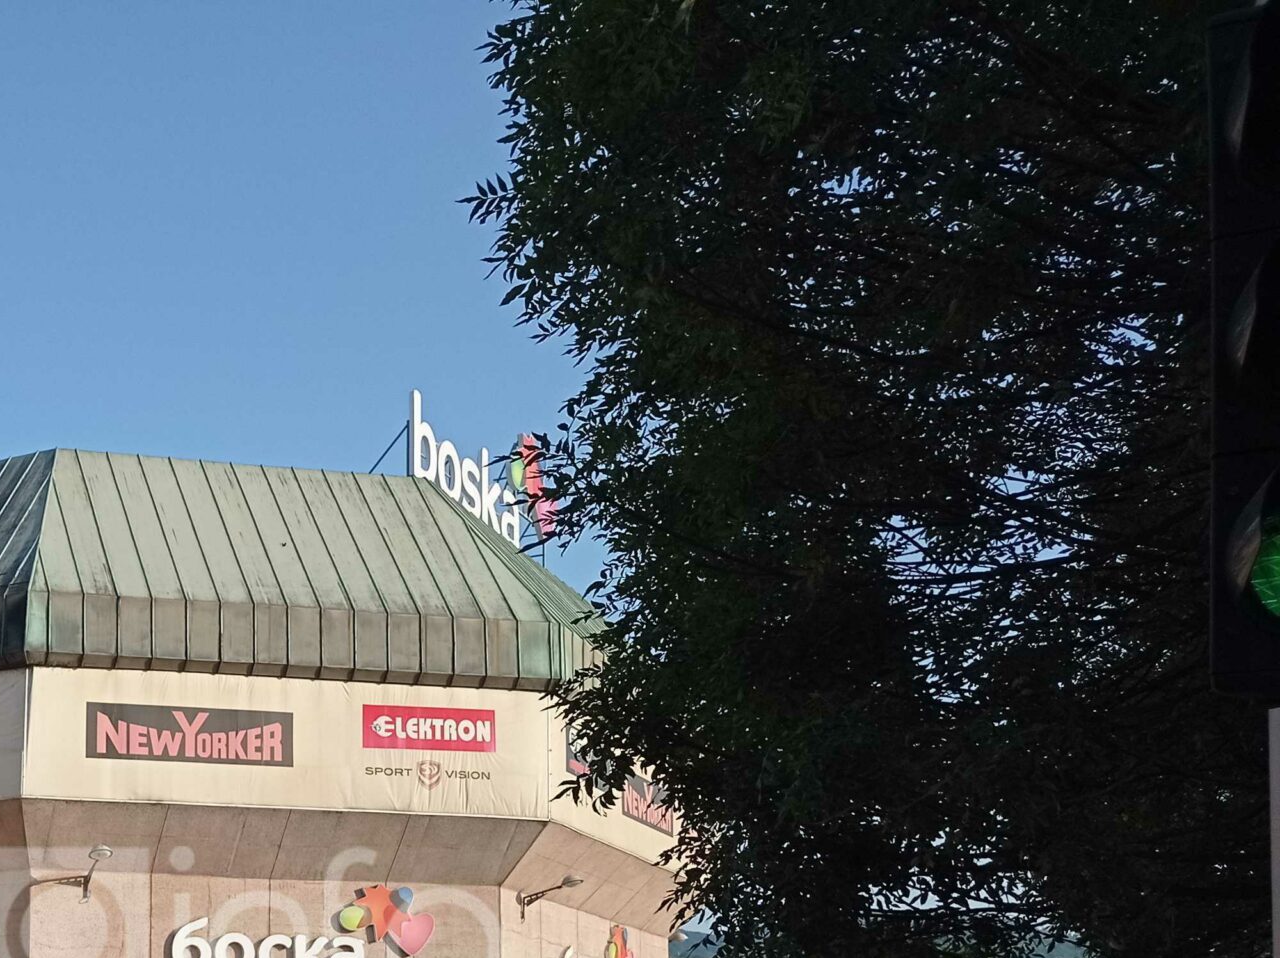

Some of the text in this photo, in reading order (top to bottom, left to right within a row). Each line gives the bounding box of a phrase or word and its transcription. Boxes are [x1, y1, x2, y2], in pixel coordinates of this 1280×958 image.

[410, 388, 520, 549] boska
[370, 715, 491, 743] ELEKTRON
[365, 766, 491, 781] SPORT VISION
